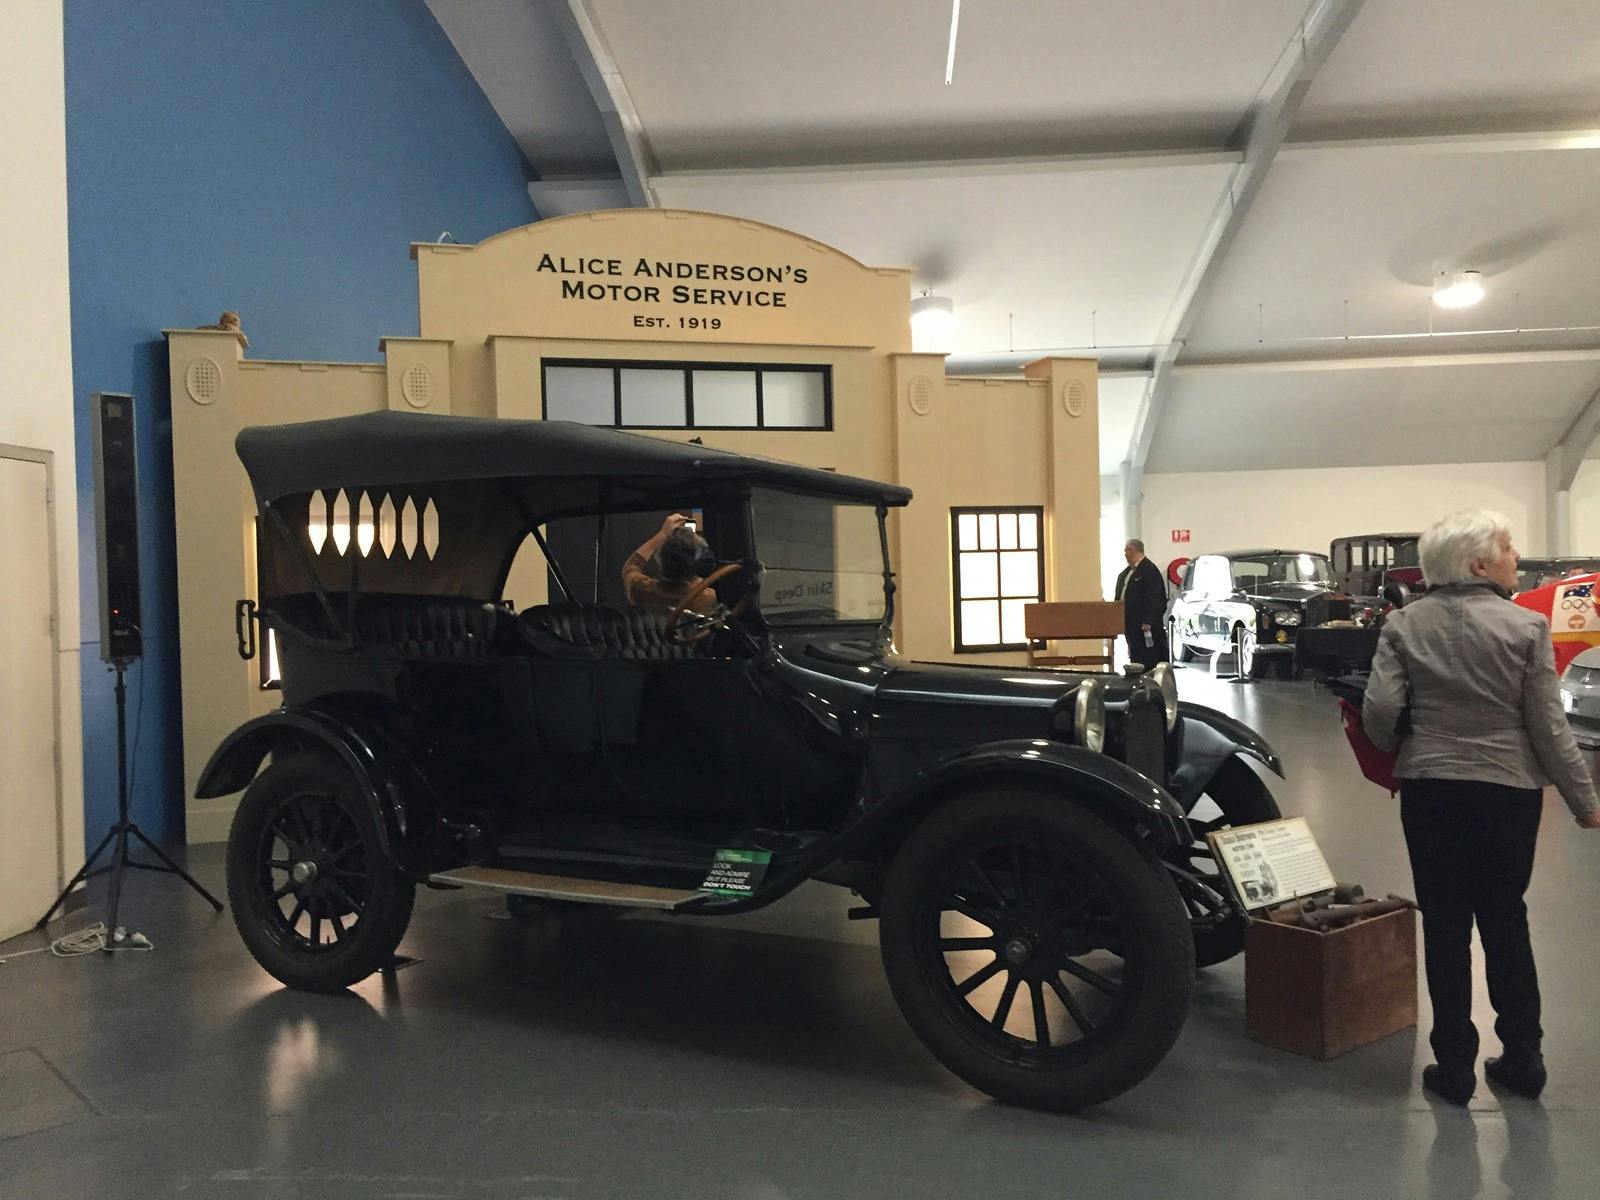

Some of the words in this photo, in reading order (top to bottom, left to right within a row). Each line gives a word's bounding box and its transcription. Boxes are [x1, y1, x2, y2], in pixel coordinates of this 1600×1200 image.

[536, 253, 622, 276] ALICE
[633, 258, 809, 284] ANDERSON'S
[561, 280, 661, 303] MOTOR
[672, 285, 787, 308] SERVICE
[633, 315, 671, 328] EST.
[679, 316, 722, 330] 1919
[721, 876, 746, 884] PLEASE
